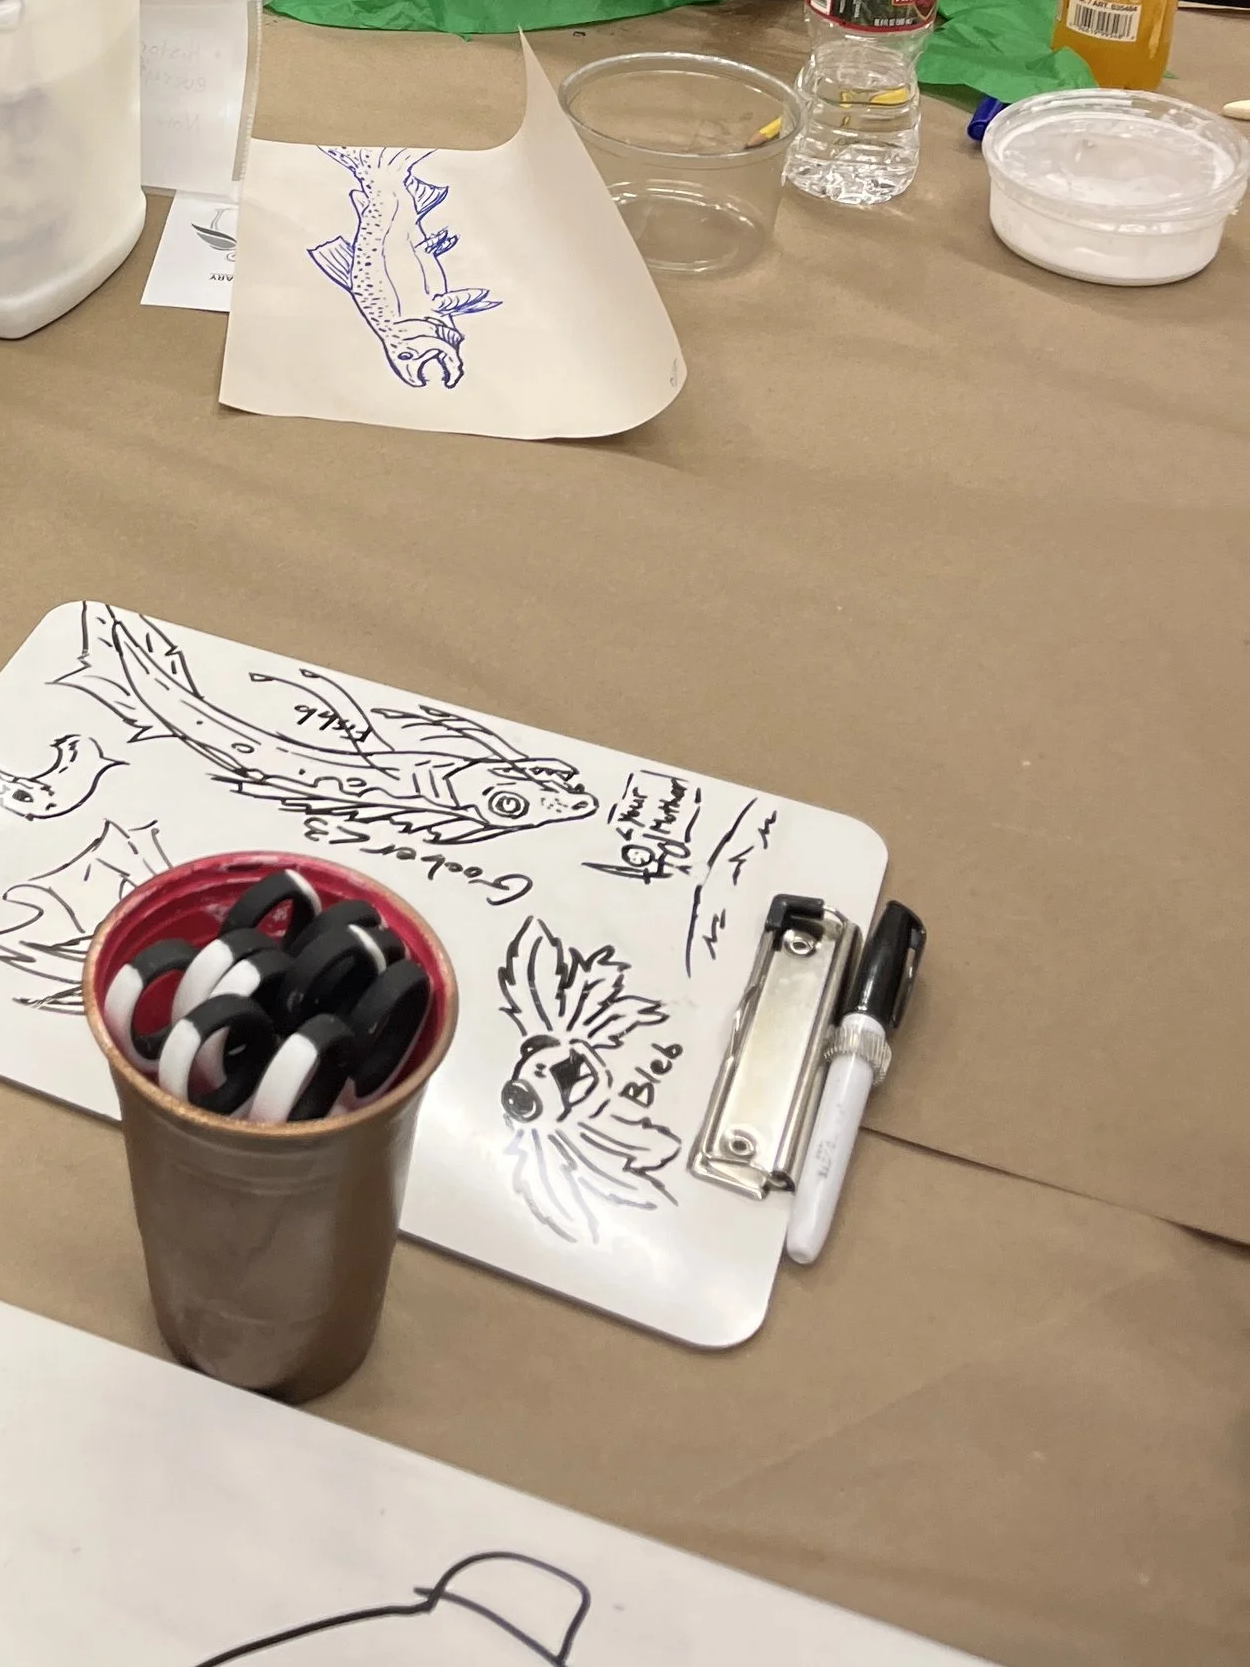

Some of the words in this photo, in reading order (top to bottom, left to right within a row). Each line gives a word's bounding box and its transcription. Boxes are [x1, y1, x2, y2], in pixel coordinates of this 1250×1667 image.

[209, 273, 234, 282] ARY
[359, 842, 534, 907] Goober
[619, 1041, 684, 1108] Bleb
